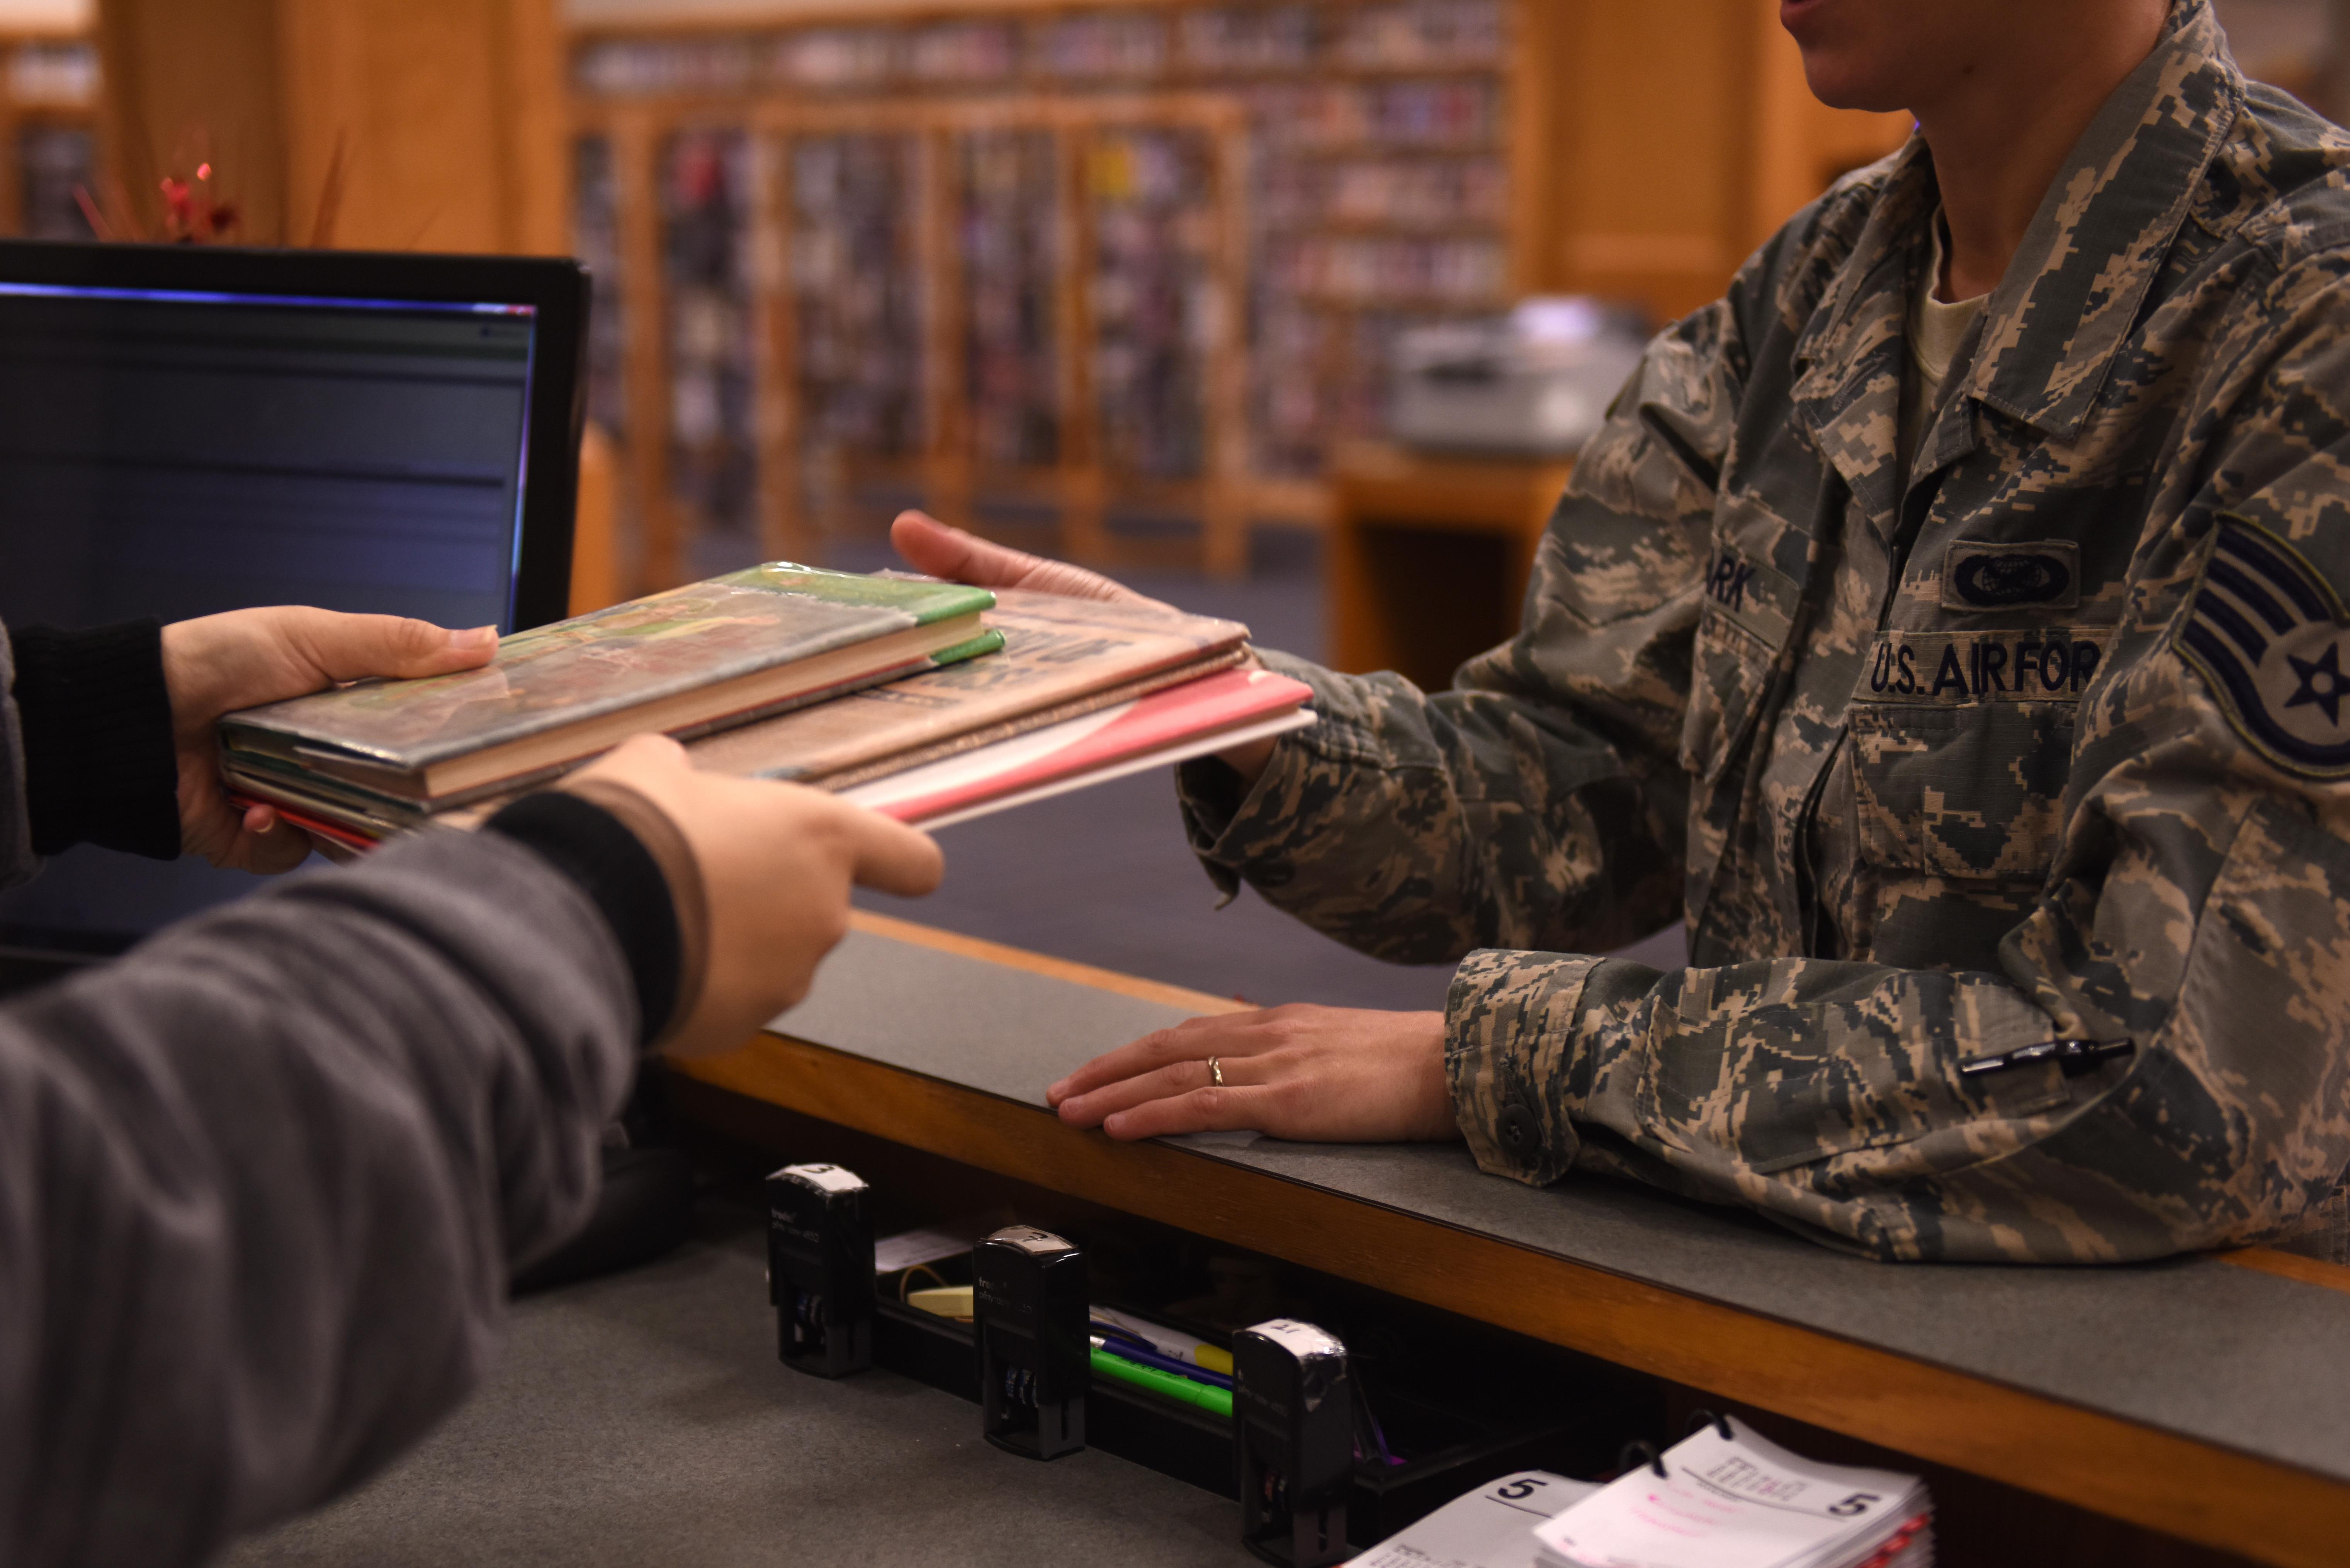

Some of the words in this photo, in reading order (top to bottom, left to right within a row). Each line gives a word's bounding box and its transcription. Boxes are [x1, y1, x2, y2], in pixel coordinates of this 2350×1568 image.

[1707, 554, 1757, 613] RK
[1871, 642, 1925, 695] U.S.
[1932, 642, 2007, 696] AIR
[1498, 1478, 1549, 1500] 5
[1828, 1492, 1881, 1517] 5
